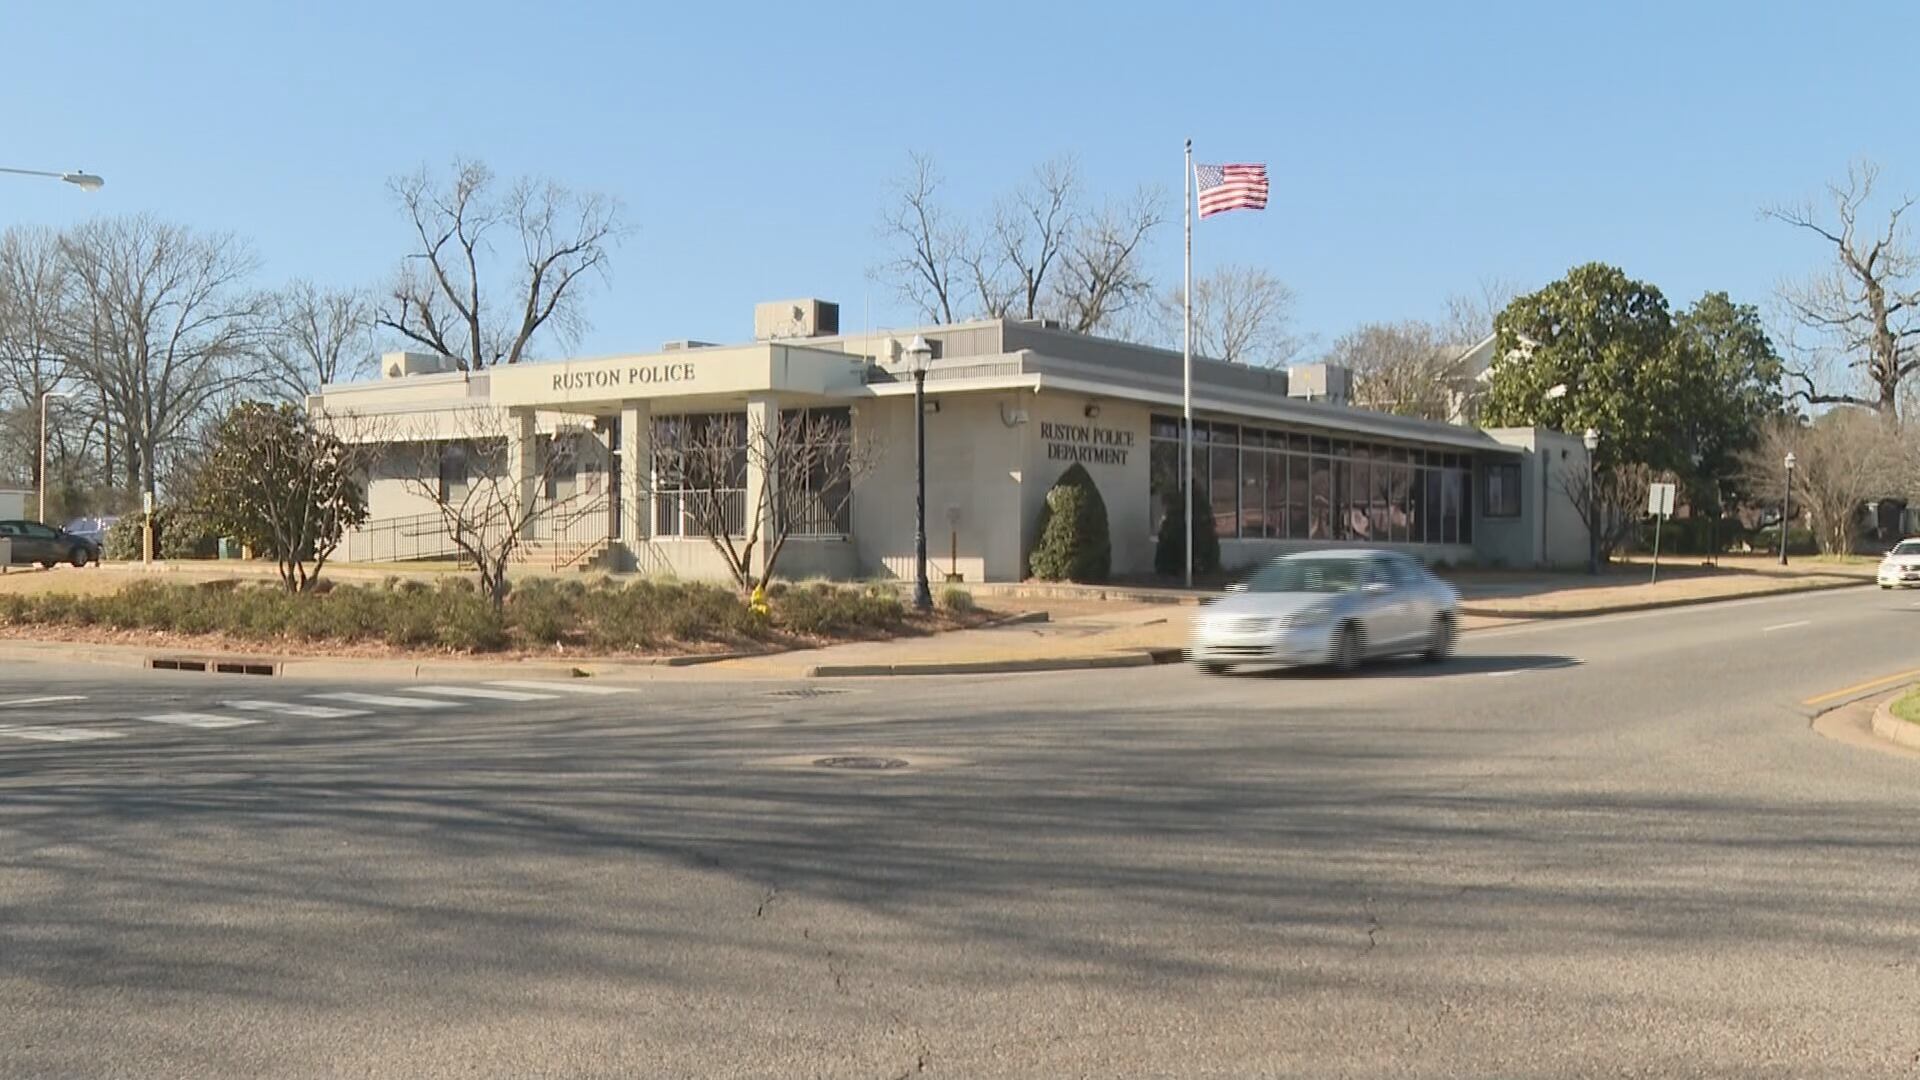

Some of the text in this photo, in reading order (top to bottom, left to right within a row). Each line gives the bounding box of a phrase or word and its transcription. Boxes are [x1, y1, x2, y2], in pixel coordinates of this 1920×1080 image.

[553, 363, 695, 390] RUSTON POLICE
[1041, 422, 1134, 447] RUSTON POLICE
[1048, 442, 1128, 465] DEPARTMENT
